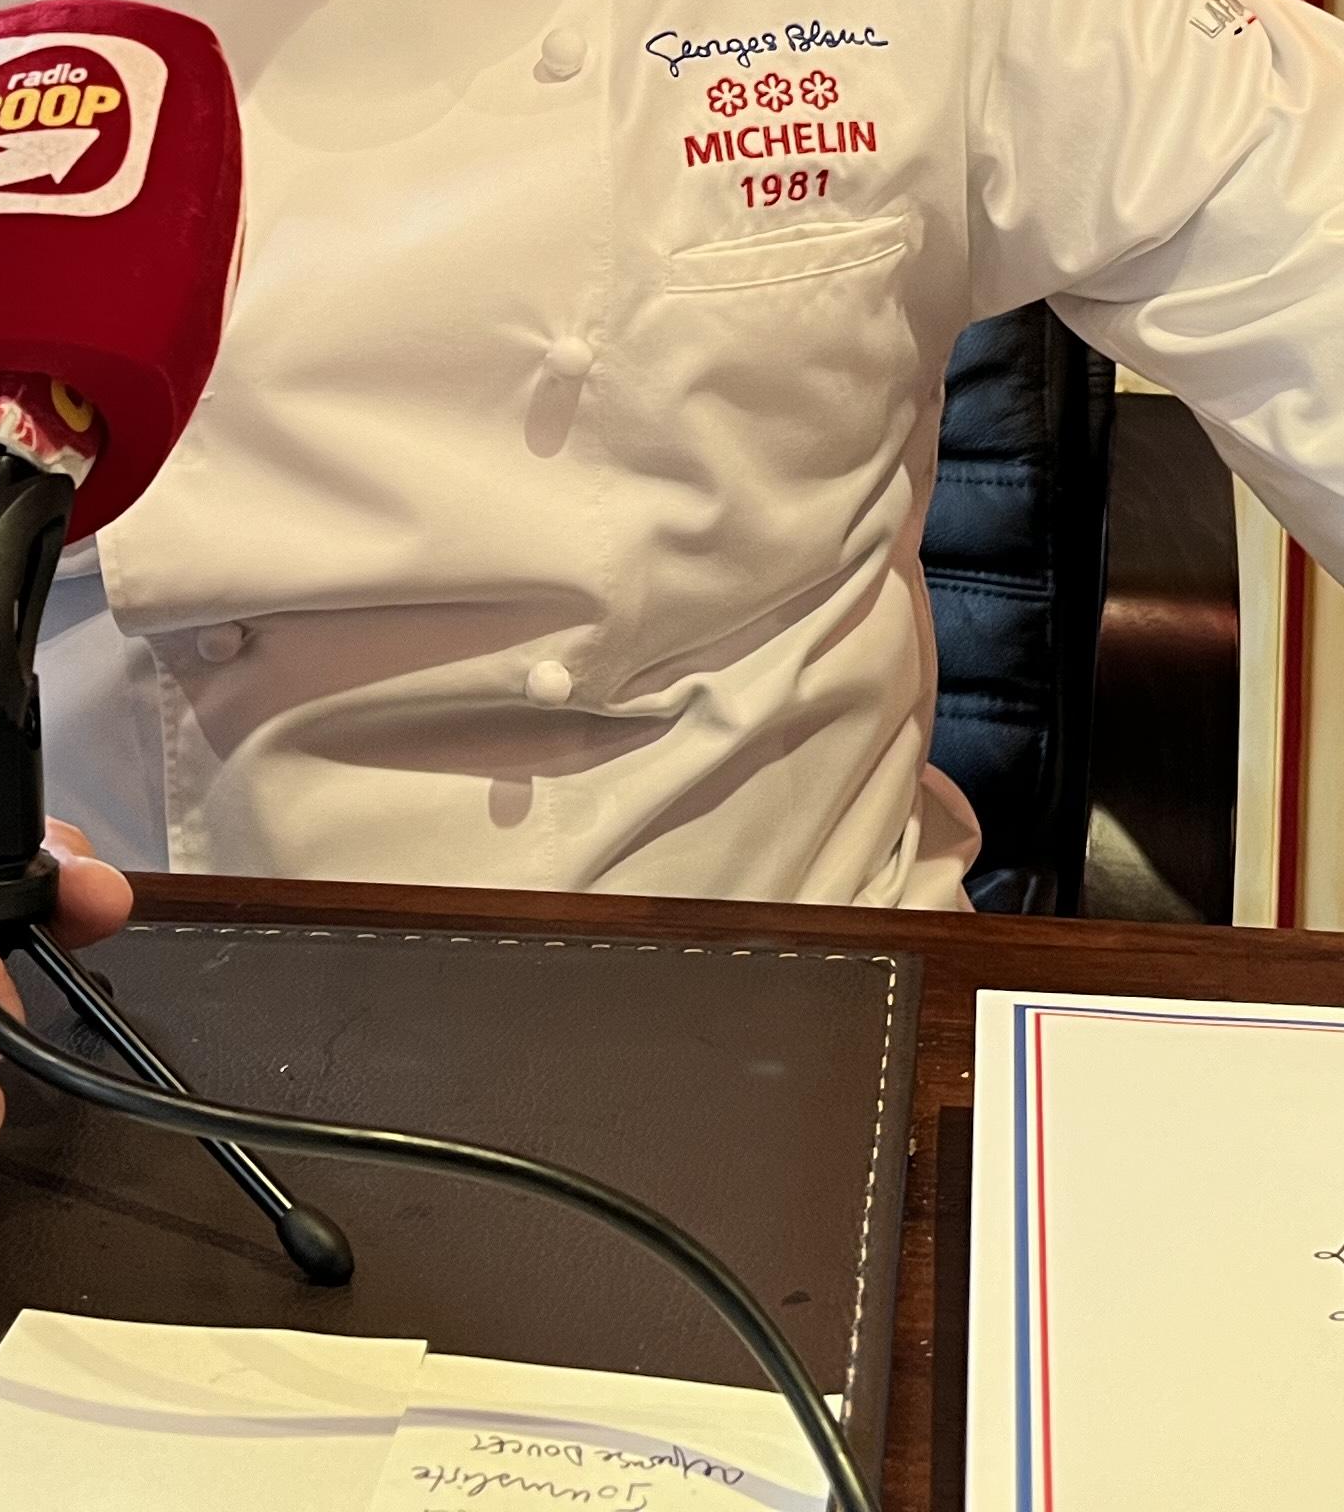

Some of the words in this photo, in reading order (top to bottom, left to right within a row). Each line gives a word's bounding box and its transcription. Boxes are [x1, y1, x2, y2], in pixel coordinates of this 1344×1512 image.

[646, 31, 778, 78] Georges
[785, 20, 889, 52] Blanc
[7, 62, 88, 90] radio
[684, 121, 878, 167] MICHELIN
[741, 169, 830, 208] 1981
